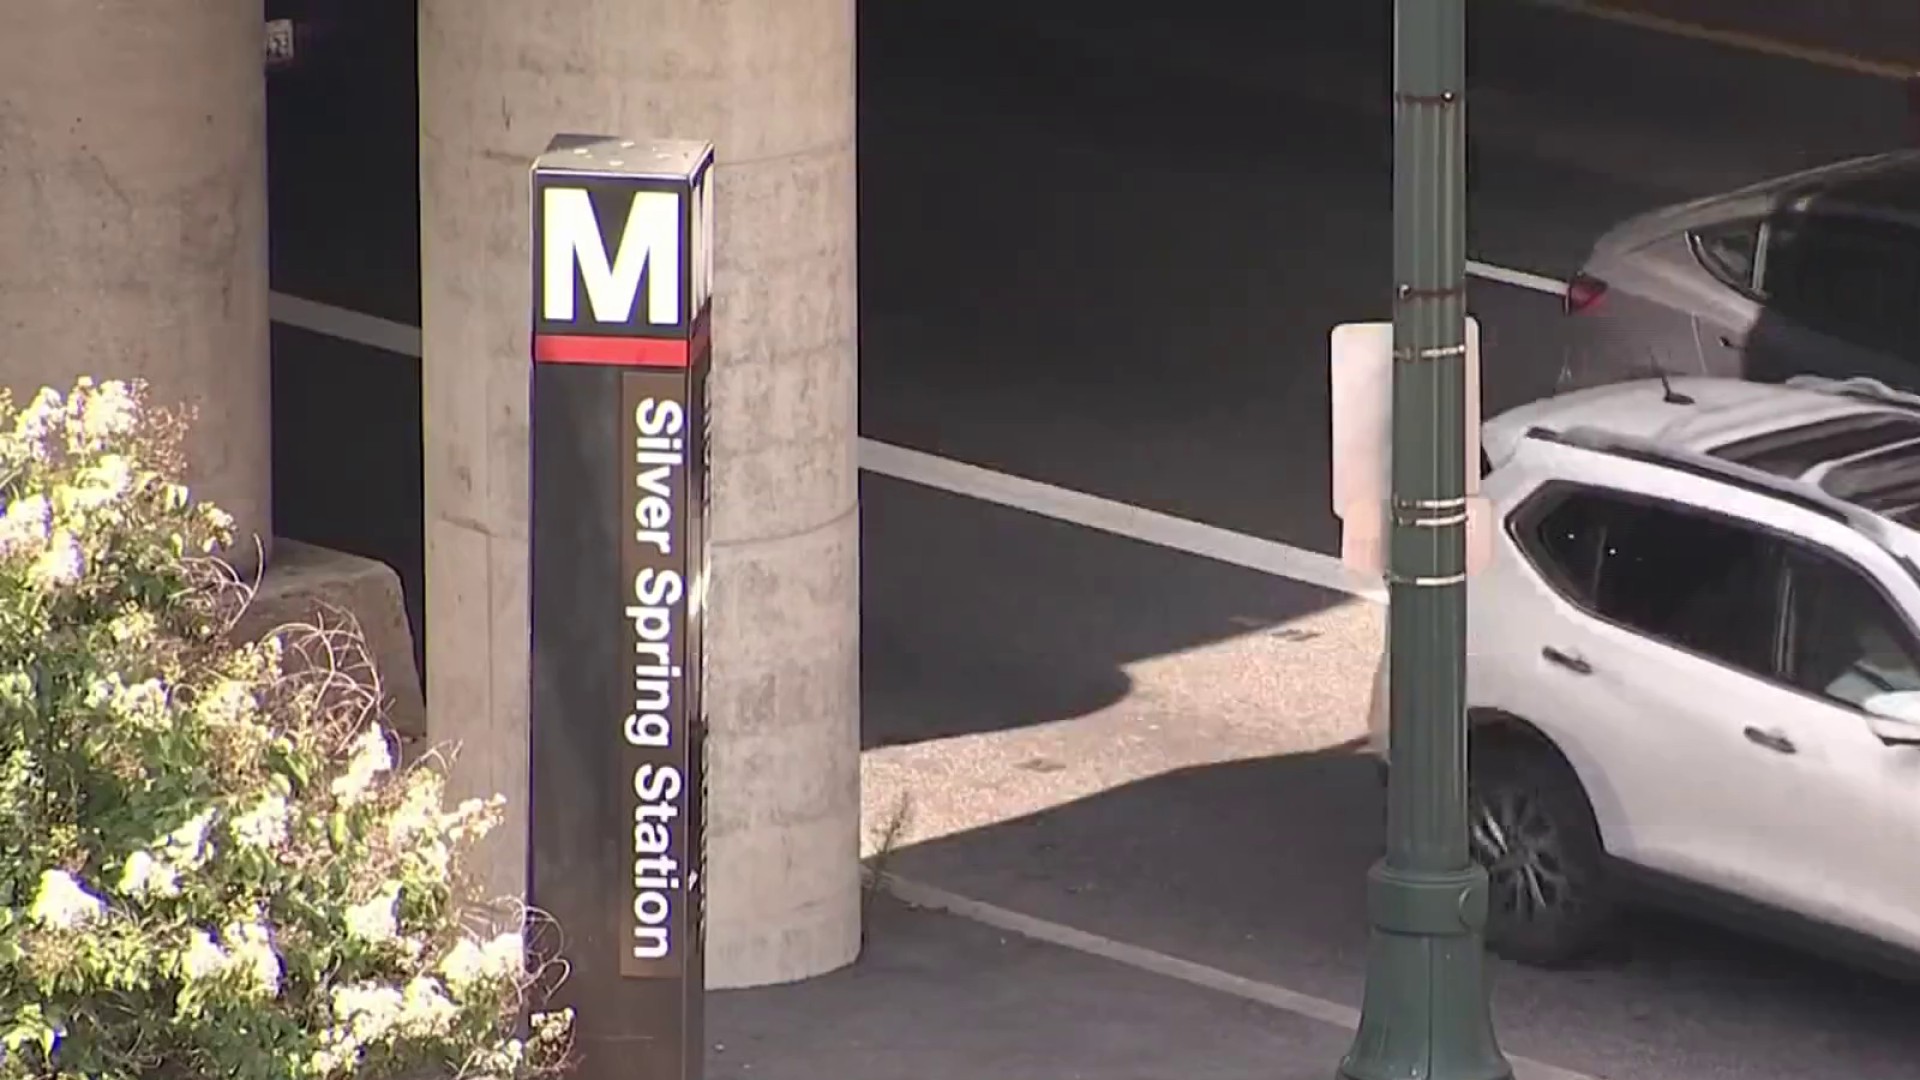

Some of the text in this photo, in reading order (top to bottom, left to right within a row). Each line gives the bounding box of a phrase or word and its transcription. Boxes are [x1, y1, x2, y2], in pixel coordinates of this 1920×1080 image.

[543, 187, 679, 325] M
[625, 397, 684, 958] Silver Spring Station
